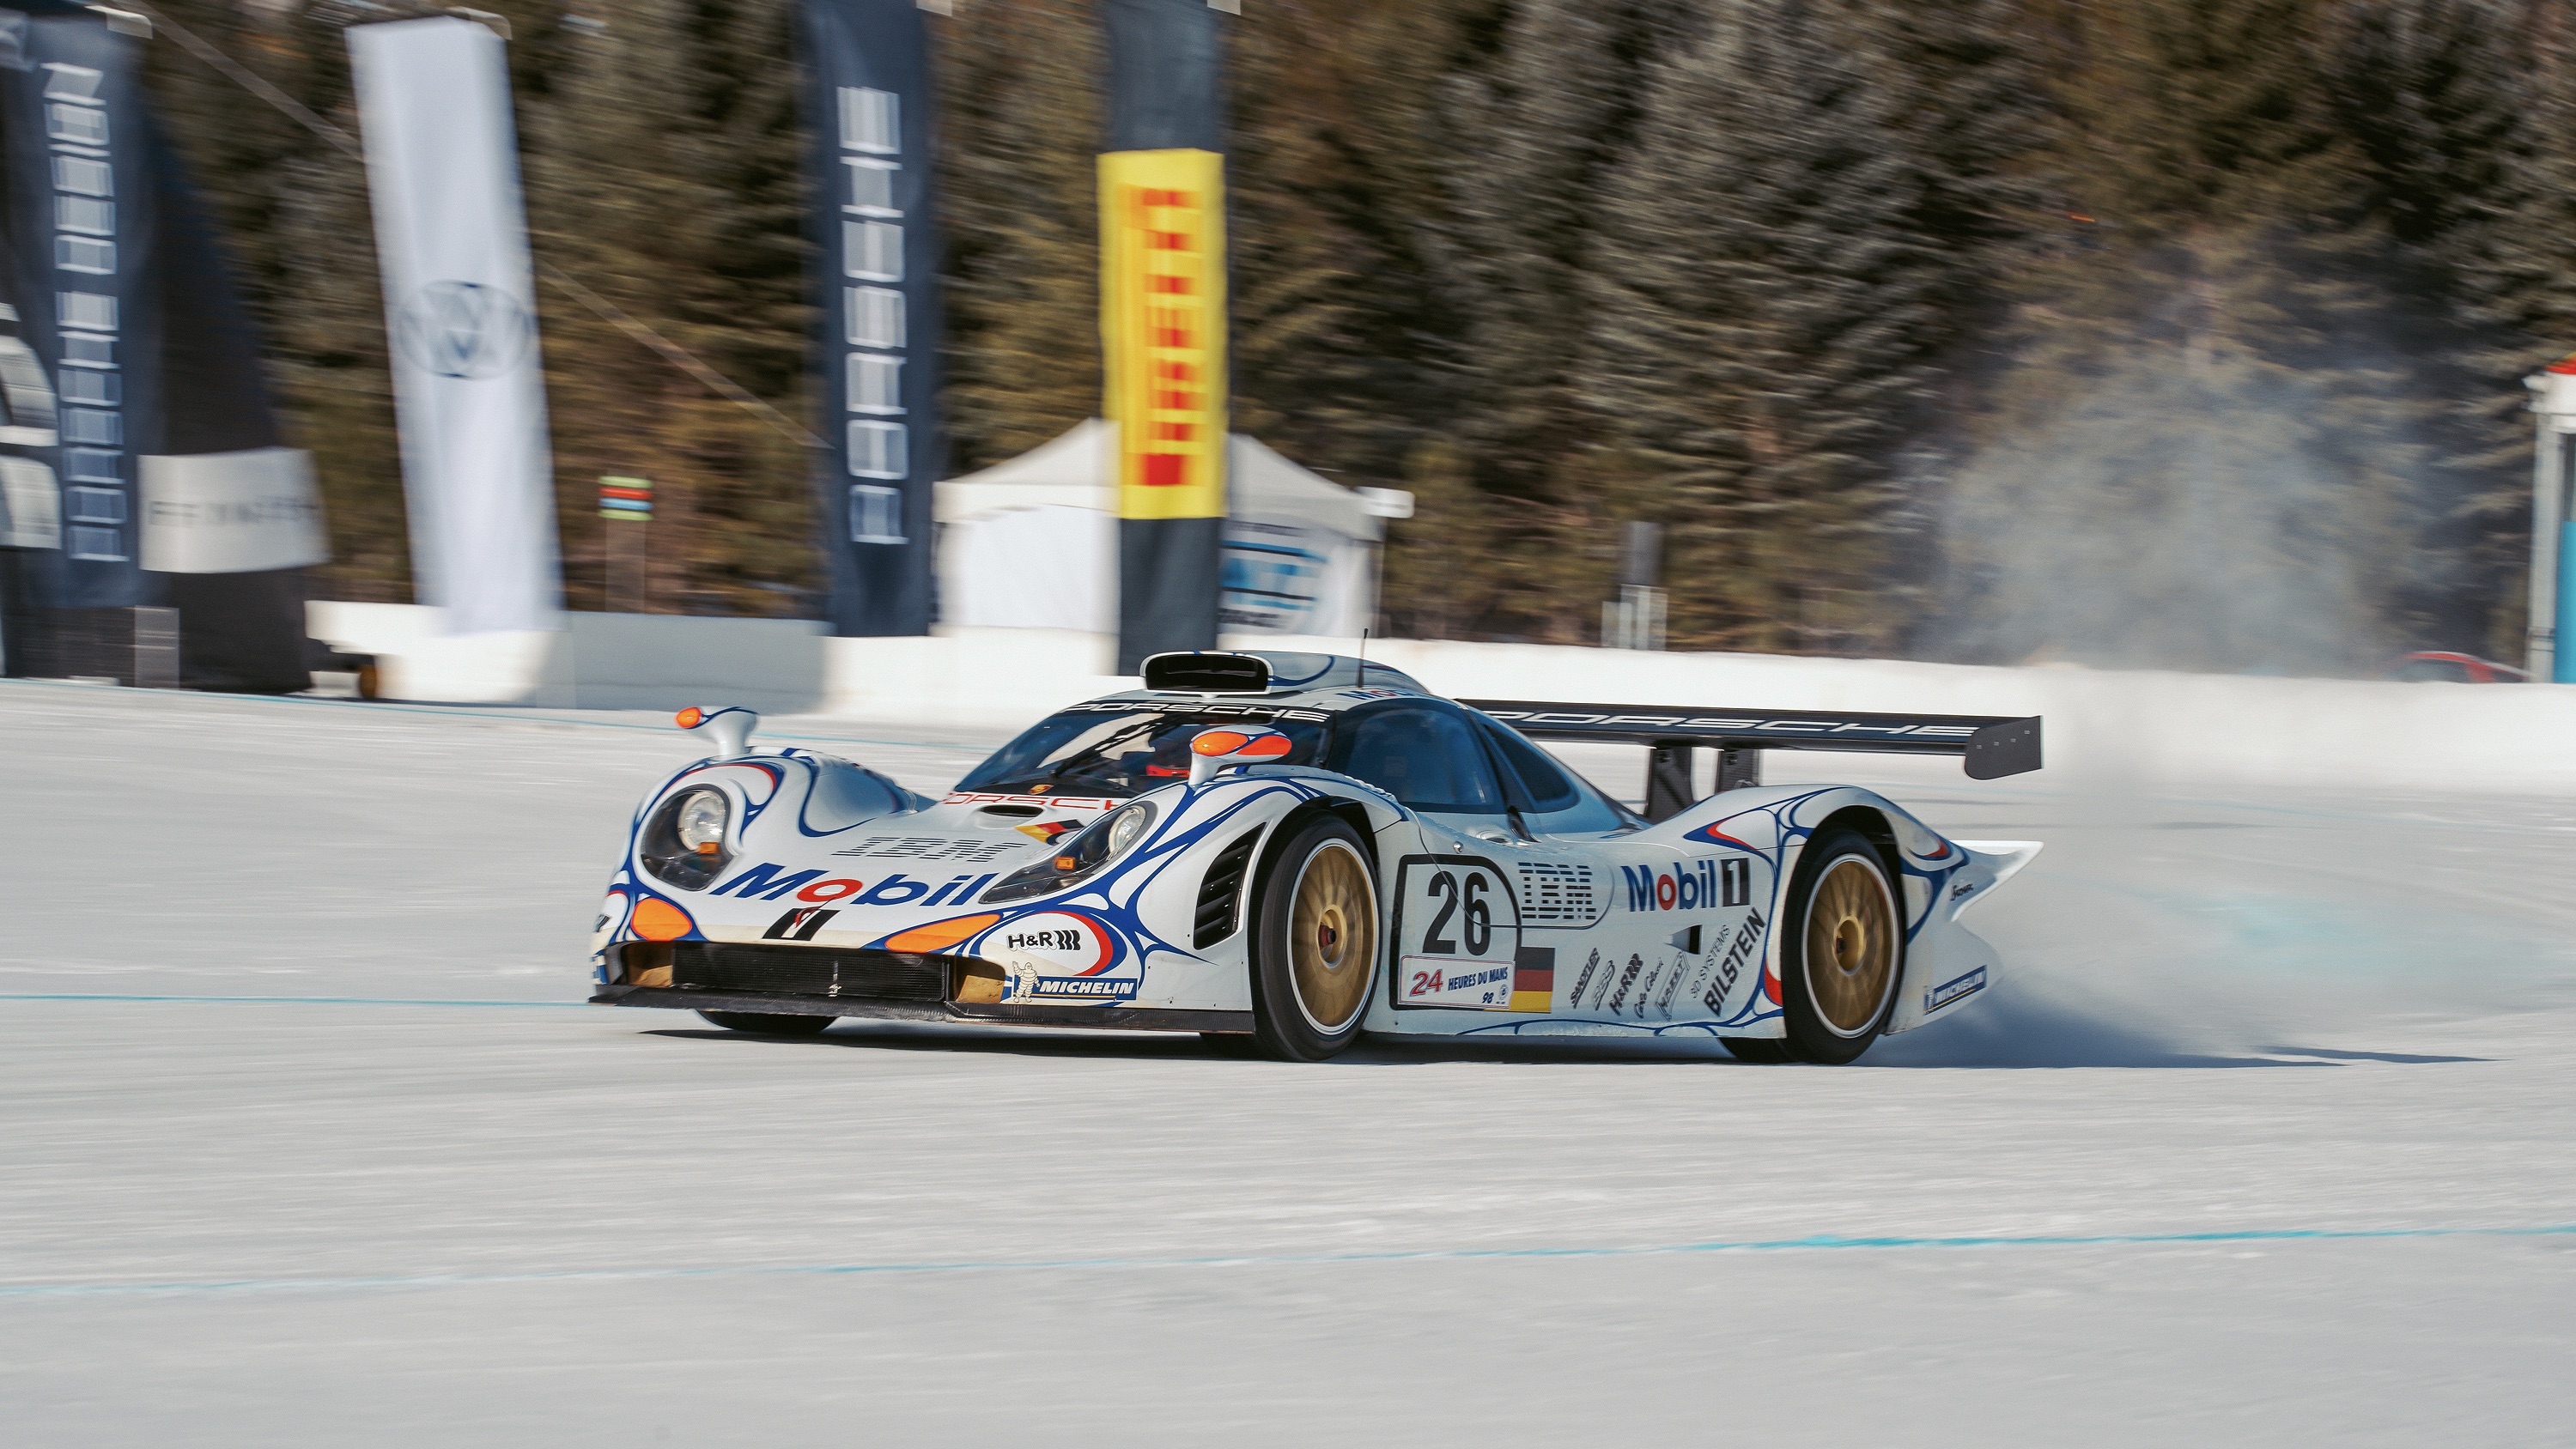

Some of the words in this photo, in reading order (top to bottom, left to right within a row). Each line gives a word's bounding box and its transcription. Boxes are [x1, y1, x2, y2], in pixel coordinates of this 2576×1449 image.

[1062, 703, 1330, 723] PORSCHE
[830, 837, 1029, 863] IBM
[708, 862, 999, 906] Mobil
[1518, 862, 1596, 920] IBM
[1620, 859, 1716, 912] Mobil
[1723, 858, 1746, 906] 1
[1422, 870, 1491, 956] 26
[1007, 931, 1058, 950] H&R
[1703, 906, 1767, 1017] BILSTEIN
[1039, 980, 1135, 994] MICHELIN
[1409, 968, 1443, 997] 24
[1448, 973, 1477, 991] HEURES
[1477, 971, 1489, 985] DU
[1489, 967, 1509, 985] MANS
[1482, 992, 1495, 1004] 98
